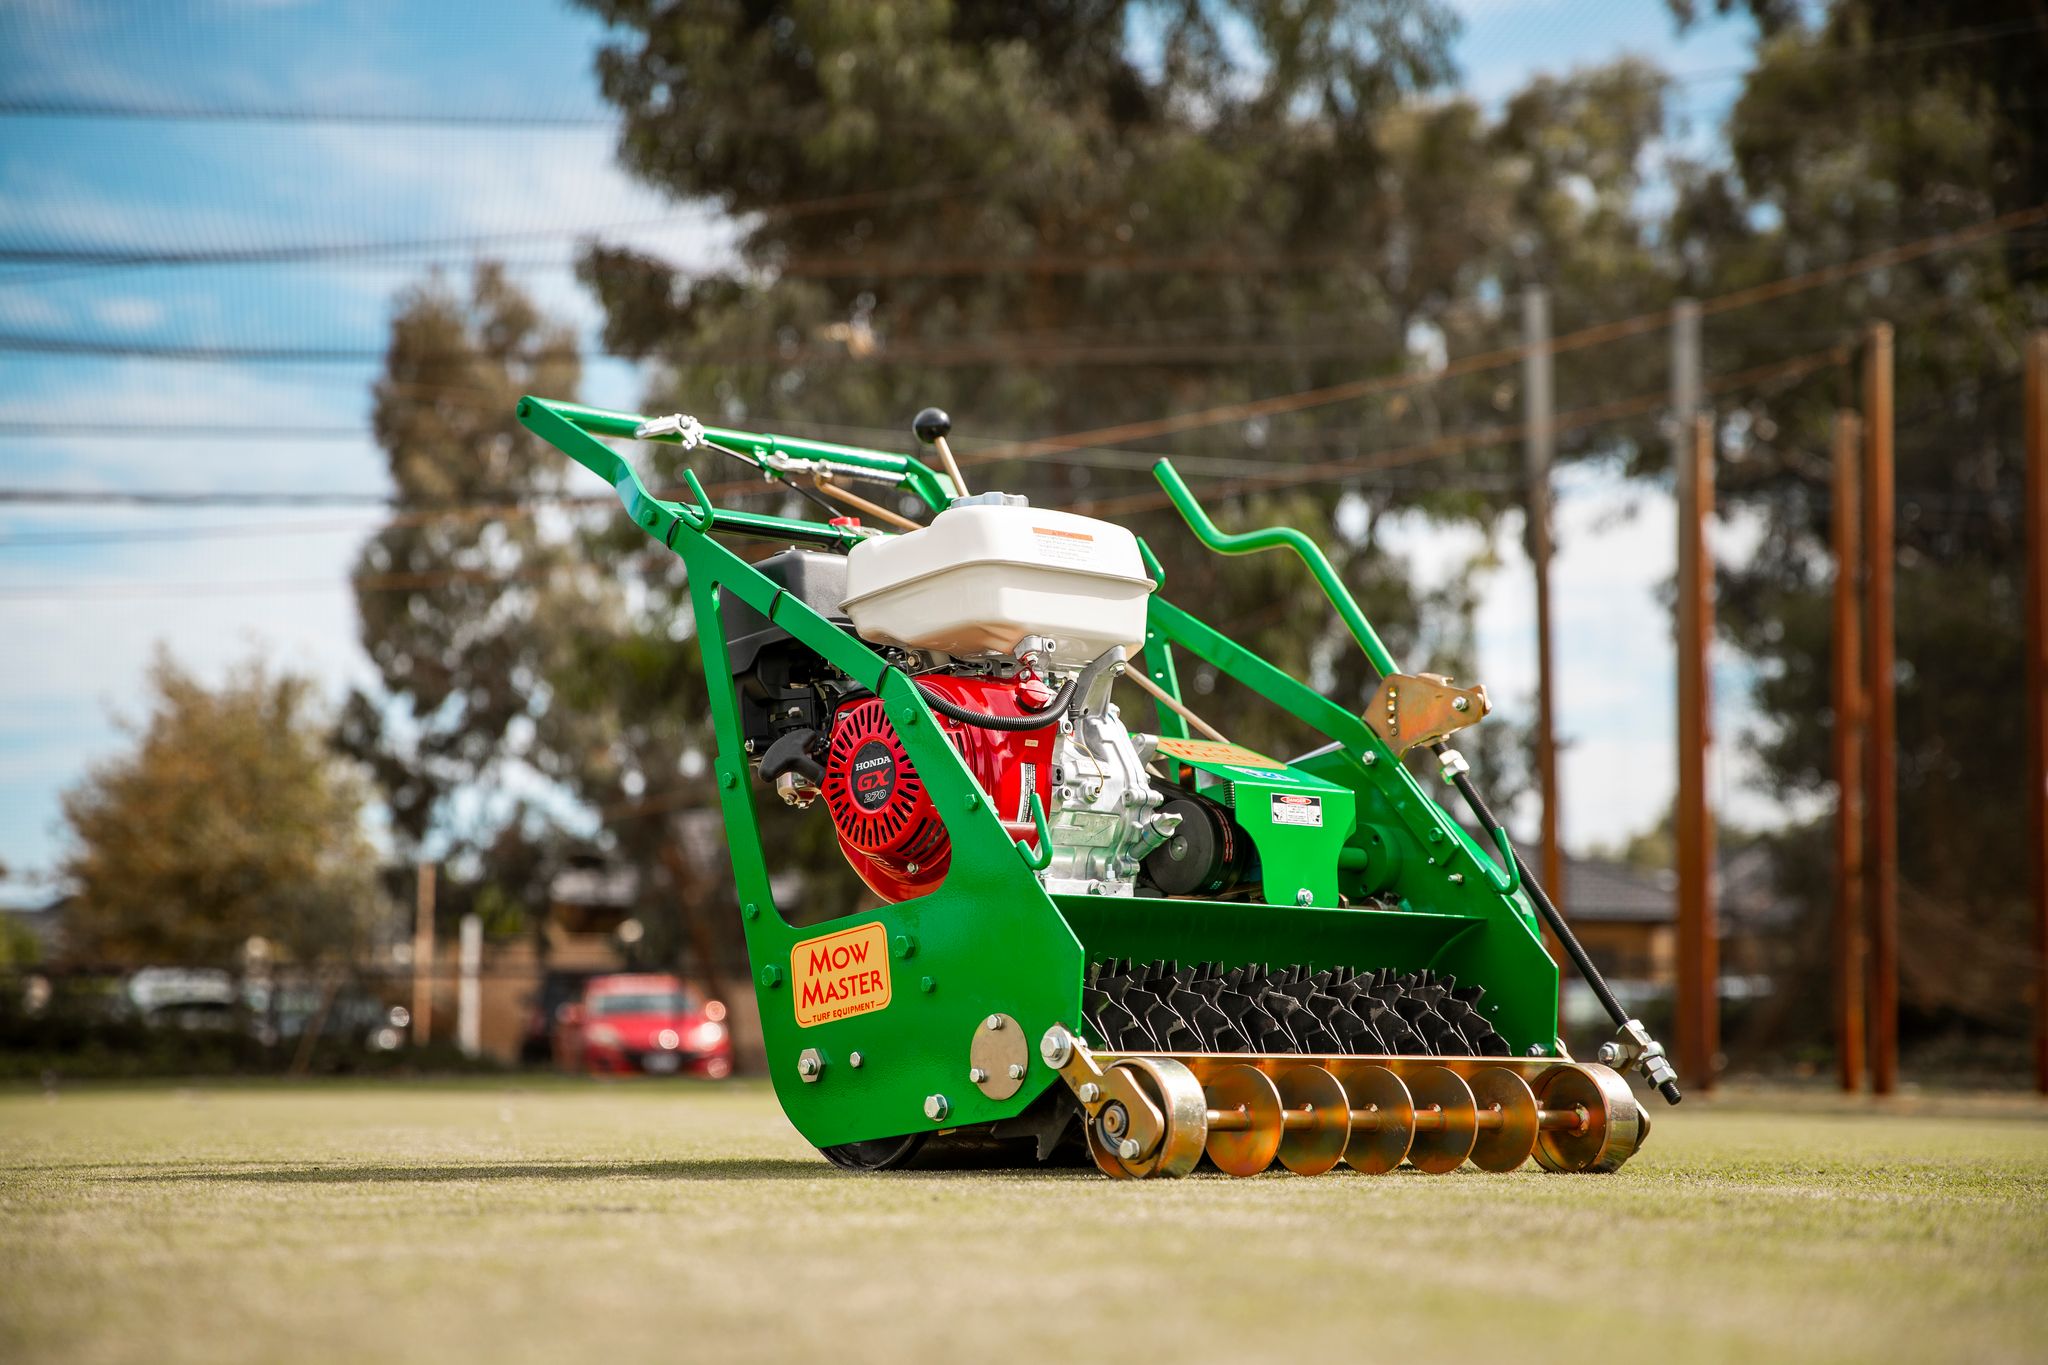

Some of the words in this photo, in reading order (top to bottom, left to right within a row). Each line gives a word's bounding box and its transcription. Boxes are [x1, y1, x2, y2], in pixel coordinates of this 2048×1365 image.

[856, 756, 891, 771] HONDA
[857, 768, 890, 792] GX
[864, 789, 886, 803] 270
[809, 941, 869, 976] MOW
[802, 970, 884, 1008] MASTER
[812, 1011, 831, 1023] TURF
[833, 1001, 875, 1018] EQUIPMENT
